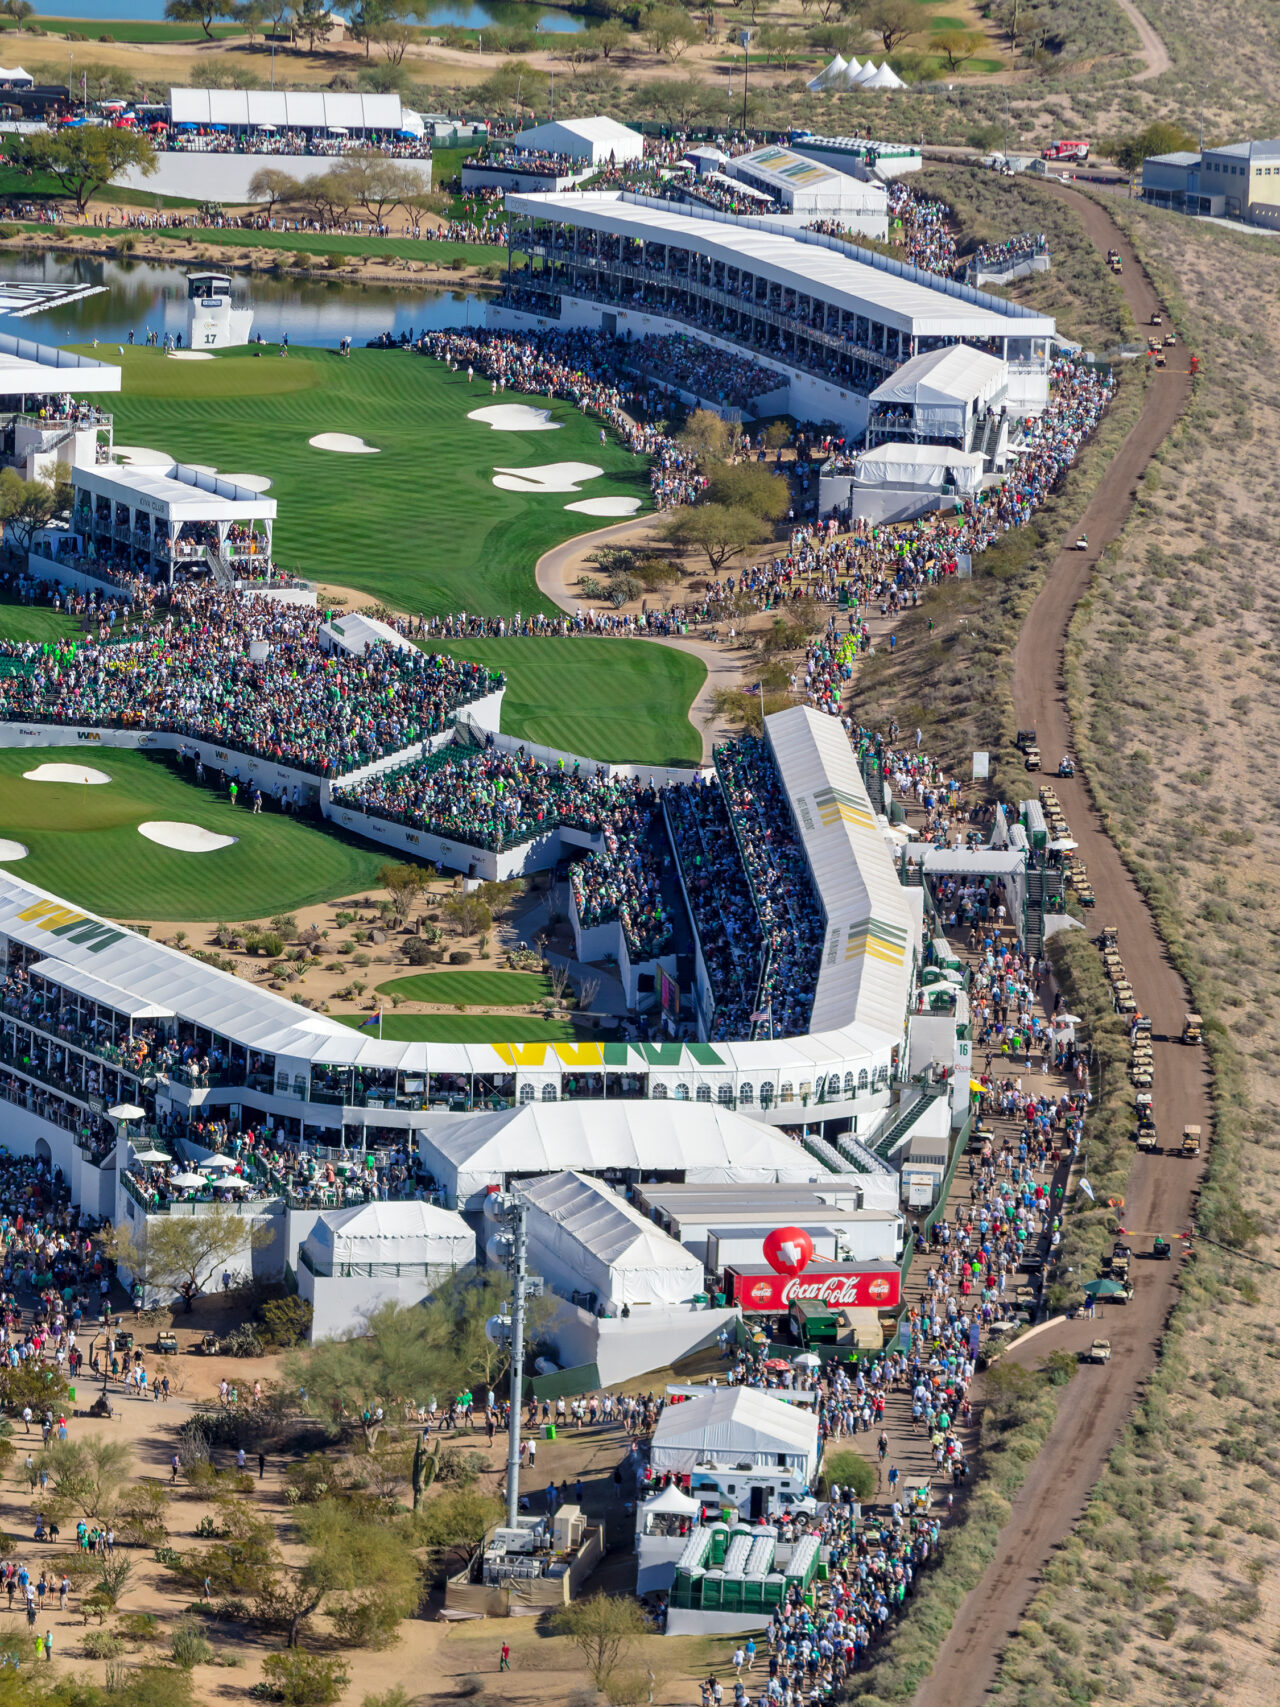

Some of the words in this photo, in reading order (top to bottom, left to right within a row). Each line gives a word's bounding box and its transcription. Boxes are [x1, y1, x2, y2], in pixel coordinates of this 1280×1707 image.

[204, 334, 217, 344] 17
[152, 501, 165, 513] CLUB
[77, 731, 101, 740] WM
[215, 750, 229, 760] WM
[405, 832, 419, 844] WM
[960, 1043, 968, 1056] 16
[750, 1289, 772, 1298] Coca-Cola
[781, 1276, 860, 1305] Coca-Cola
[868, 1285, 890, 1294] Coca-Cola
